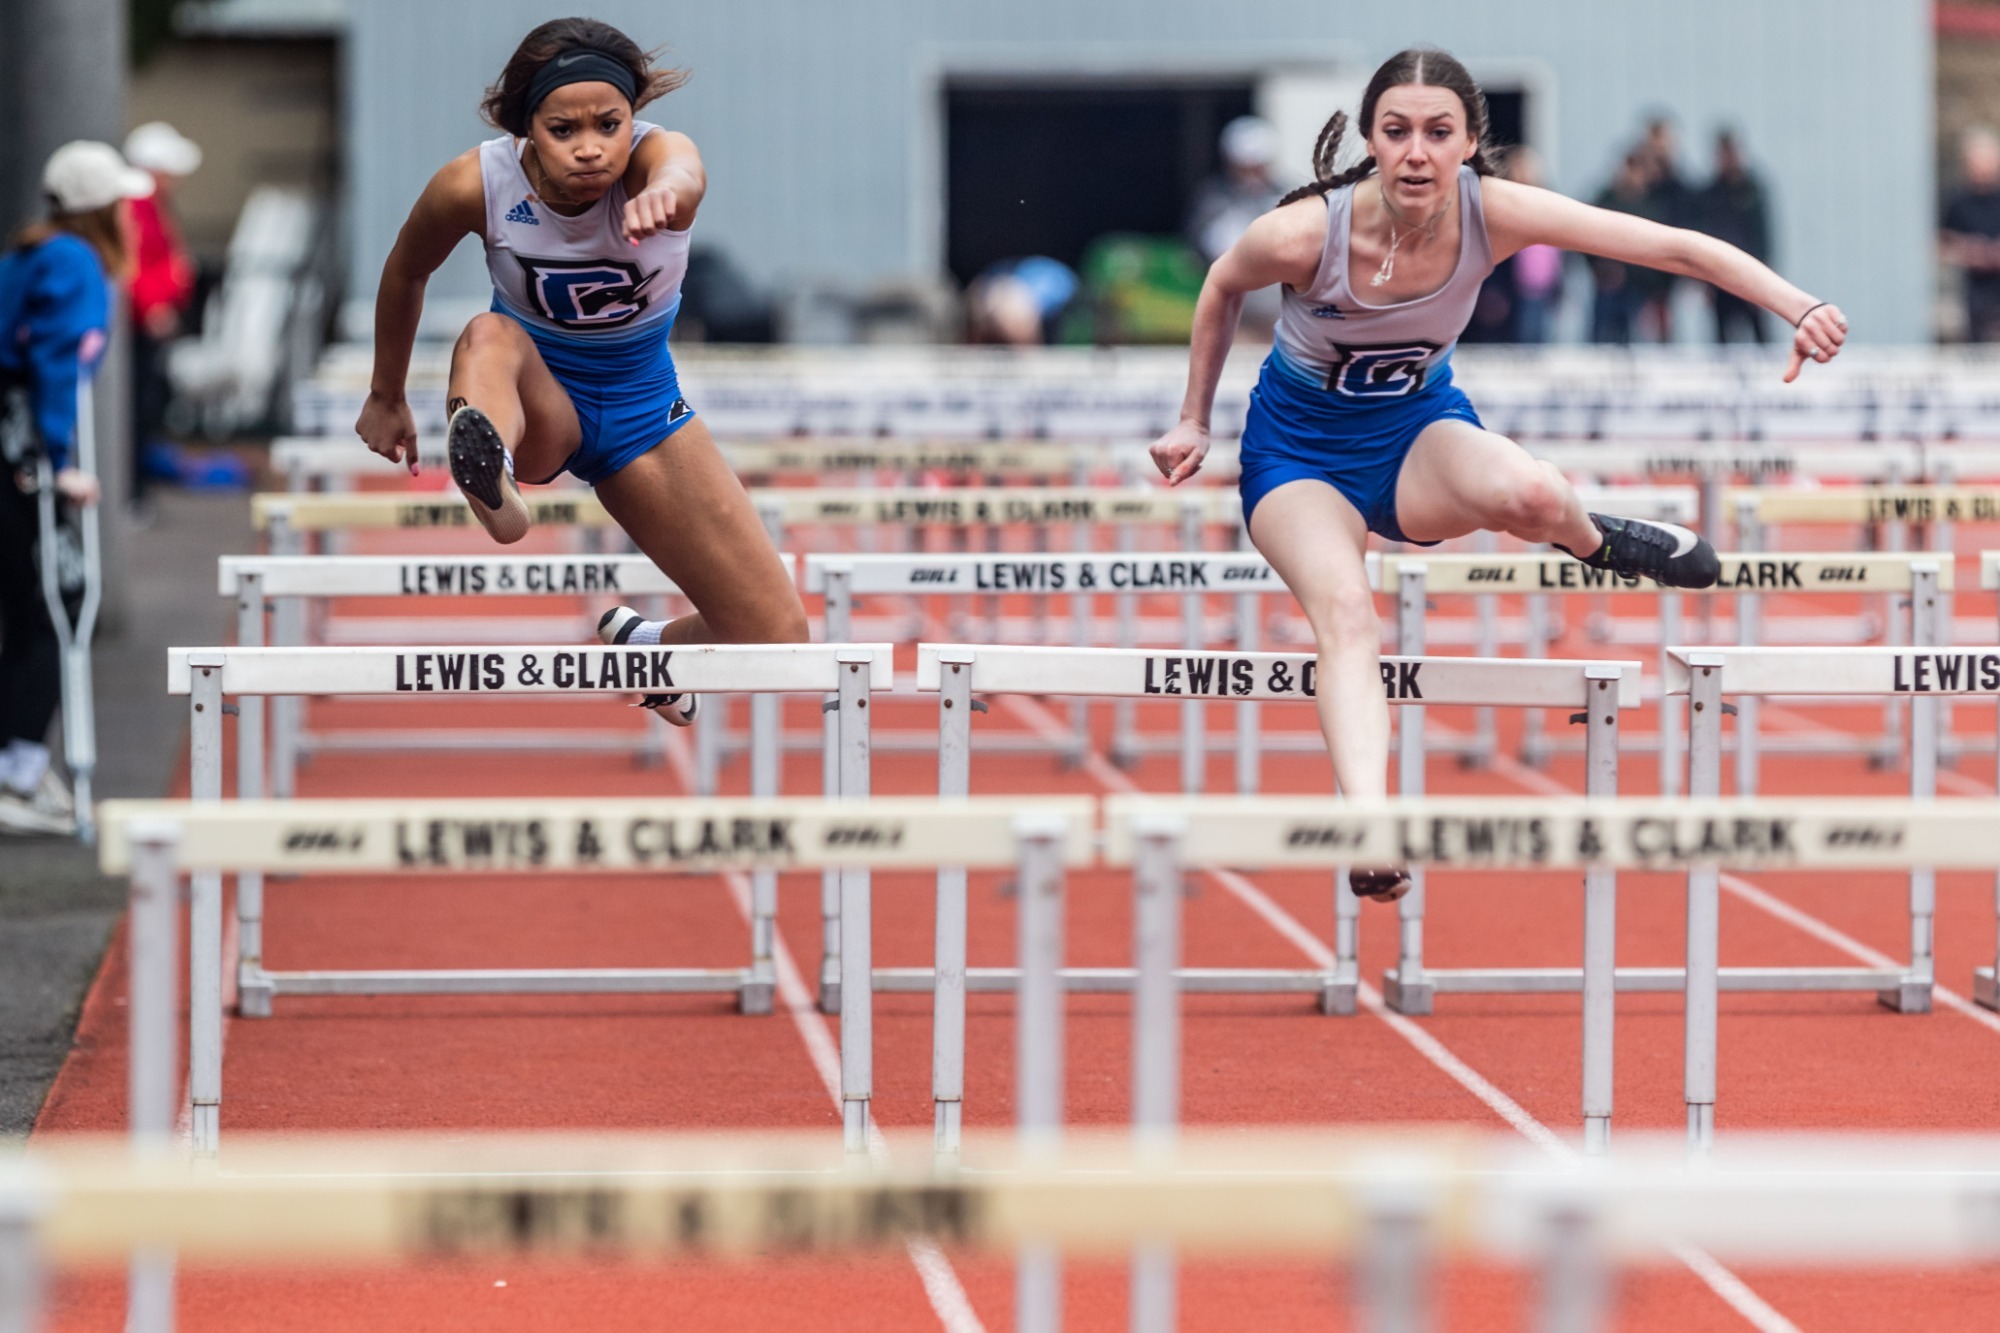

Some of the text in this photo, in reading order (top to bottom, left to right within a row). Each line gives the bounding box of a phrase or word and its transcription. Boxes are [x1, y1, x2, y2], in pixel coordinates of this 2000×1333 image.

[505, 210, 539, 225] adidas
[402, 563, 620, 594] LEWIS & CLARK
[976, 563, 1065, 589] LEWIS
[1079, 562, 1096, 588] &
[1110, 562, 1208, 588] CLARK
[1468, 567, 1517, 582] GILL
[1717, 561, 1801, 588] LARK
[1819, 566, 1868, 581] GILL
[396, 651, 675, 691] LEWIS & CLARK
[1145, 657, 1423, 699] LEWIS & CRK
[1894, 655, 2000, 691] LEWIS
[397, 819, 547, 867] LEWIS
[628, 817, 796, 865] CLARK
[1402, 818, 1551, 863] LEWIS
[1629, 816, 1799, 862] CLARK
